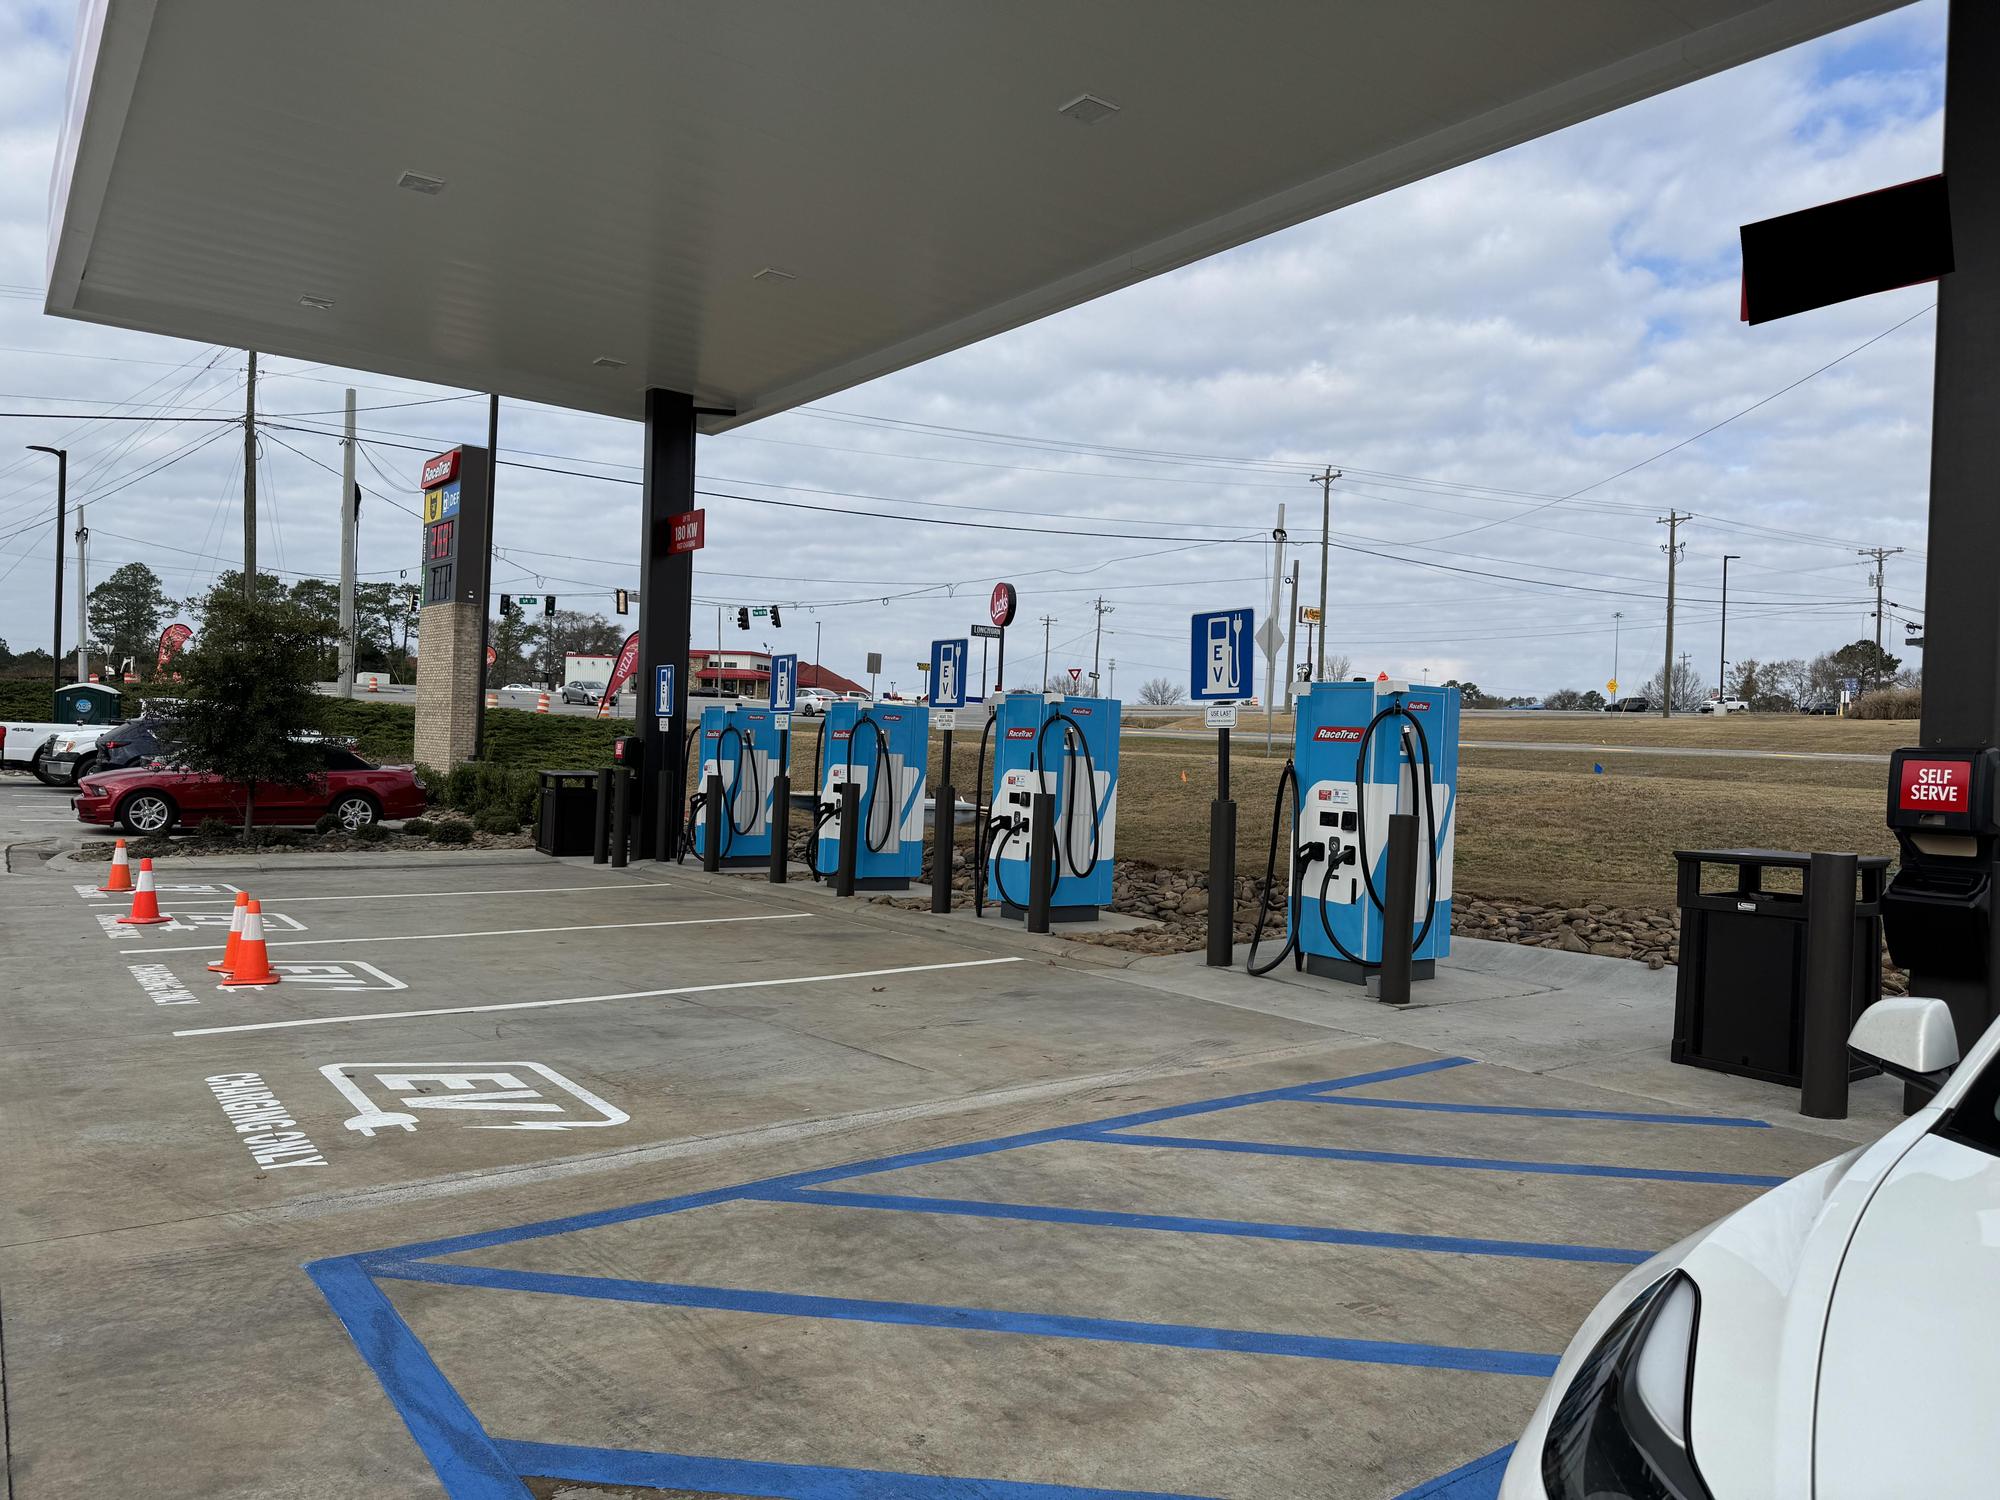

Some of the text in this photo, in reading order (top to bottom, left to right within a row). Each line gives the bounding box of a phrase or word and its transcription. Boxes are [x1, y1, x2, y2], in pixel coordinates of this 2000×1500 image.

[424, 461, 451, 482] RaceTrac
[686, 522, 698, 539] KW
[616, 650, 636, 679] PIZZA
[1008, 729, 1033, 738] RaceTrac
[1317, 729, 1360, 740] RaceTrac
[1918, 768, 1953, 785] SELF
[1910, 784, 1958, 802] SERVE
[374, 1072, 566, 1112] EV
[204, 1072, 329, 1170] CHARGING ONLY
